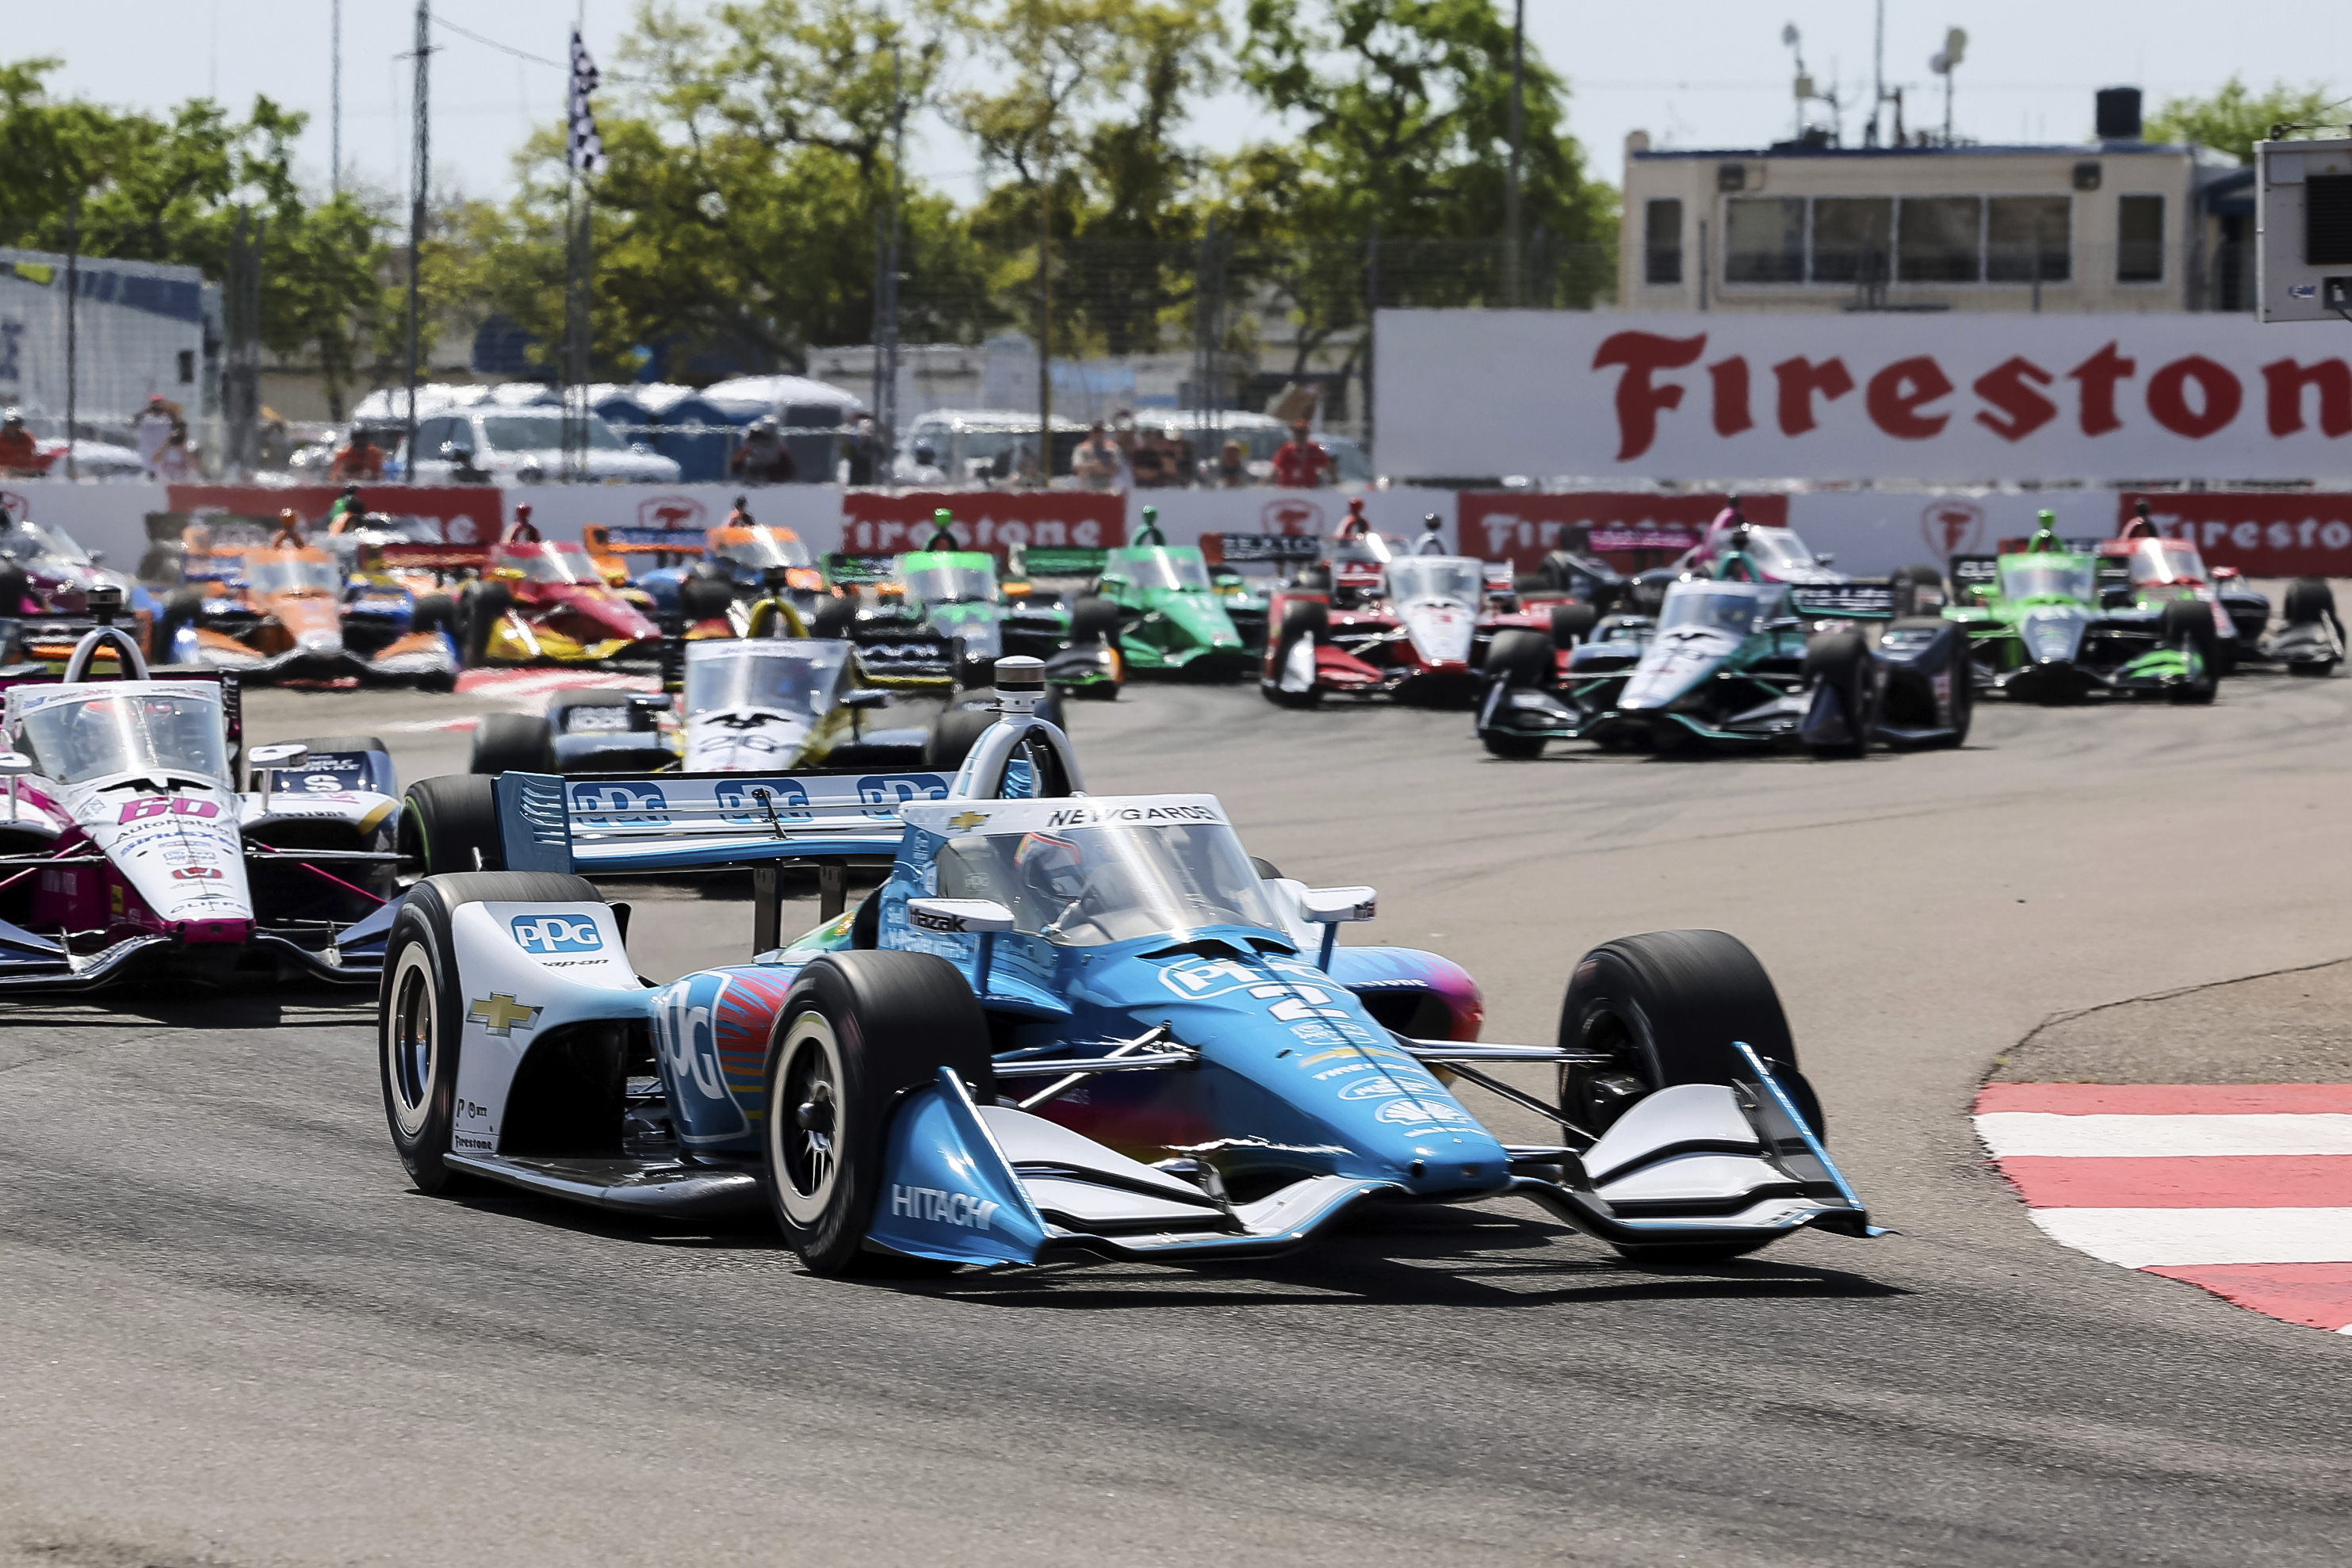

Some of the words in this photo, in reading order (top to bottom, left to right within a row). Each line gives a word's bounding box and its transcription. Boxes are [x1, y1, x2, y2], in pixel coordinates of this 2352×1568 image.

[117, 796, 220, 825] 60
[514, 918, 600, 951] PPG
[909, 908, 969, 934] Mazak
[892, 1184, 1000, 1231] HITACHI
